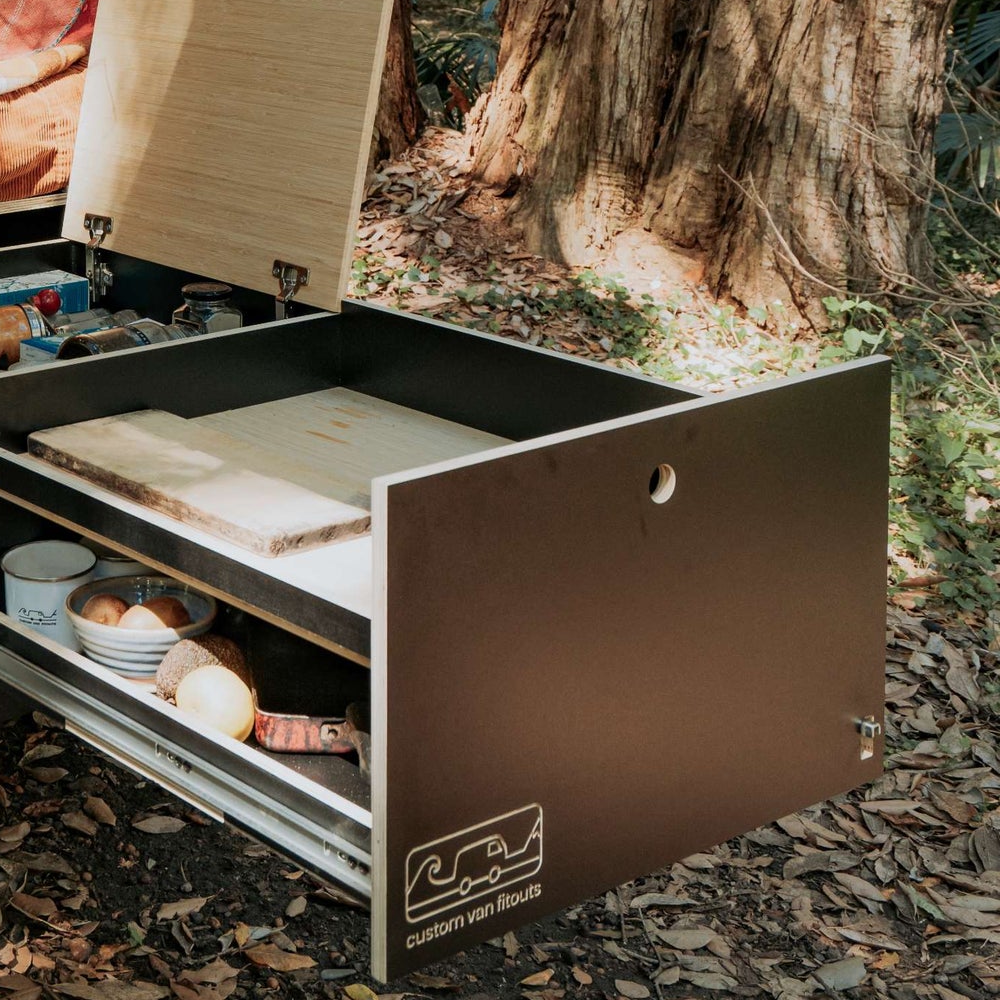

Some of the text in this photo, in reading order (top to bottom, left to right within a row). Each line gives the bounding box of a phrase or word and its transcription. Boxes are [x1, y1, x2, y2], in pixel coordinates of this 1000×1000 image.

[405, 883, 542, 949] custom van fitouts
